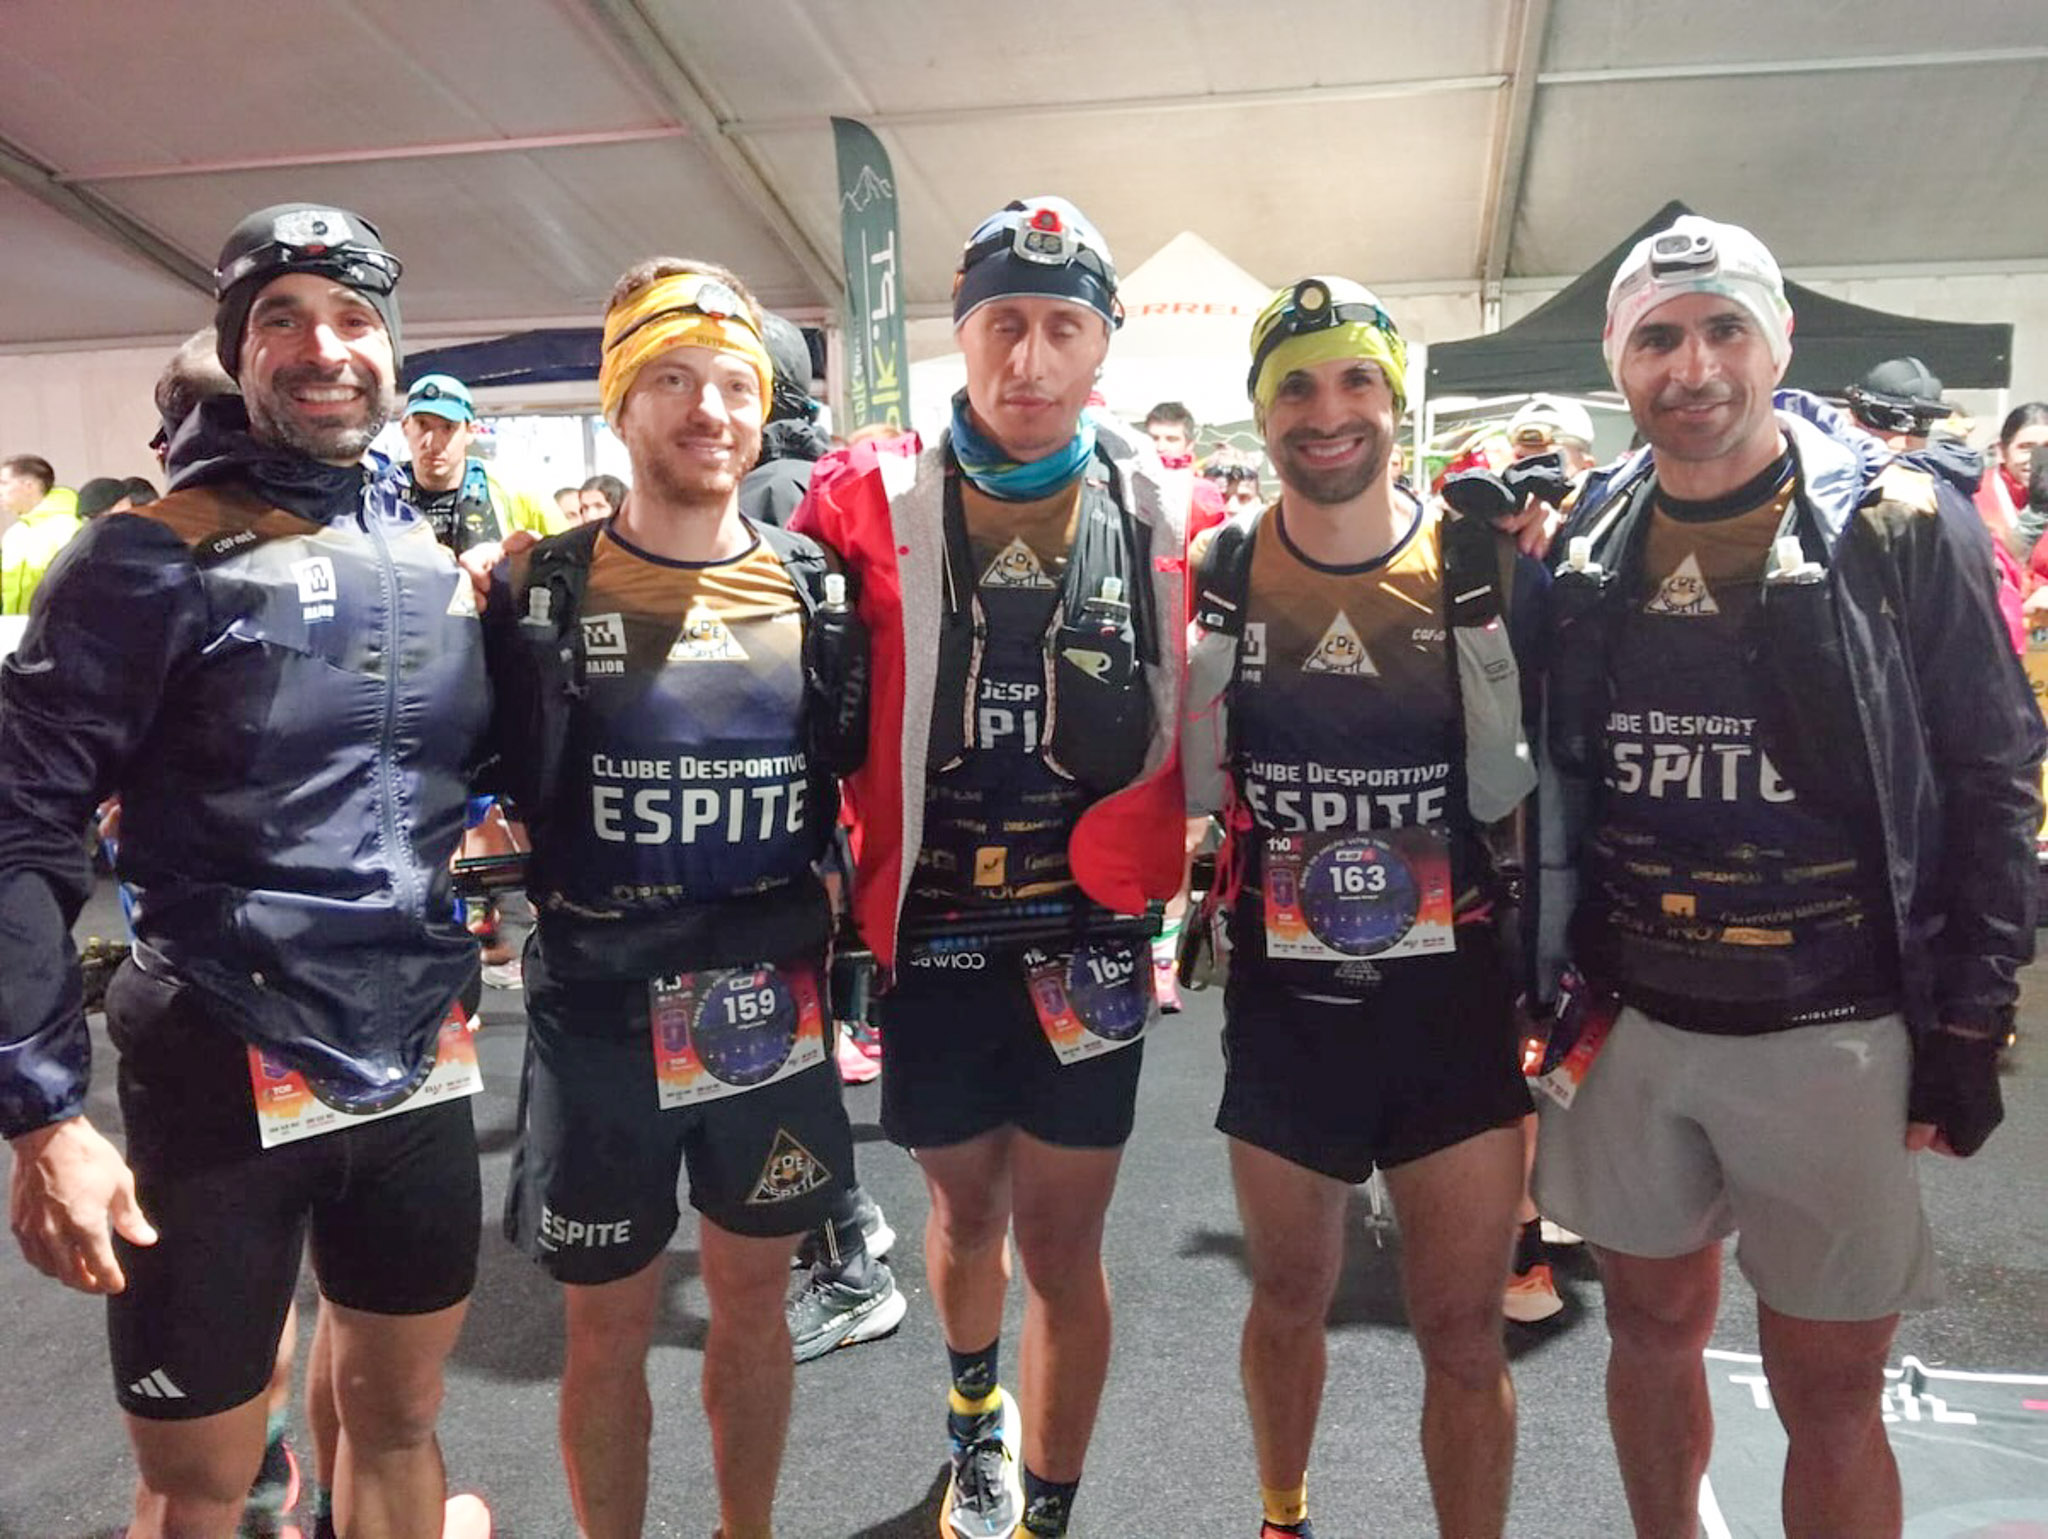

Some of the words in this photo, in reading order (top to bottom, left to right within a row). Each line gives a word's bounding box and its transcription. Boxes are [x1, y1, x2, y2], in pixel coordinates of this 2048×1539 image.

[1119, 302, 1263, 318] ERREL
[1649, 710, 1759, 737] DESPORT
[592, 754, 672, 780] CLUBE
[679, 752, 807, 780] DESPORTIVO
[1307, 762, 1450, 787] DESPORTIVO
[592, 779, 808, 845] ESPITE
[1329, 864, 1387, 894] 163
[722, 987, 776, 1025] 159
[541, 1204, 632, 1248] ESPITE
